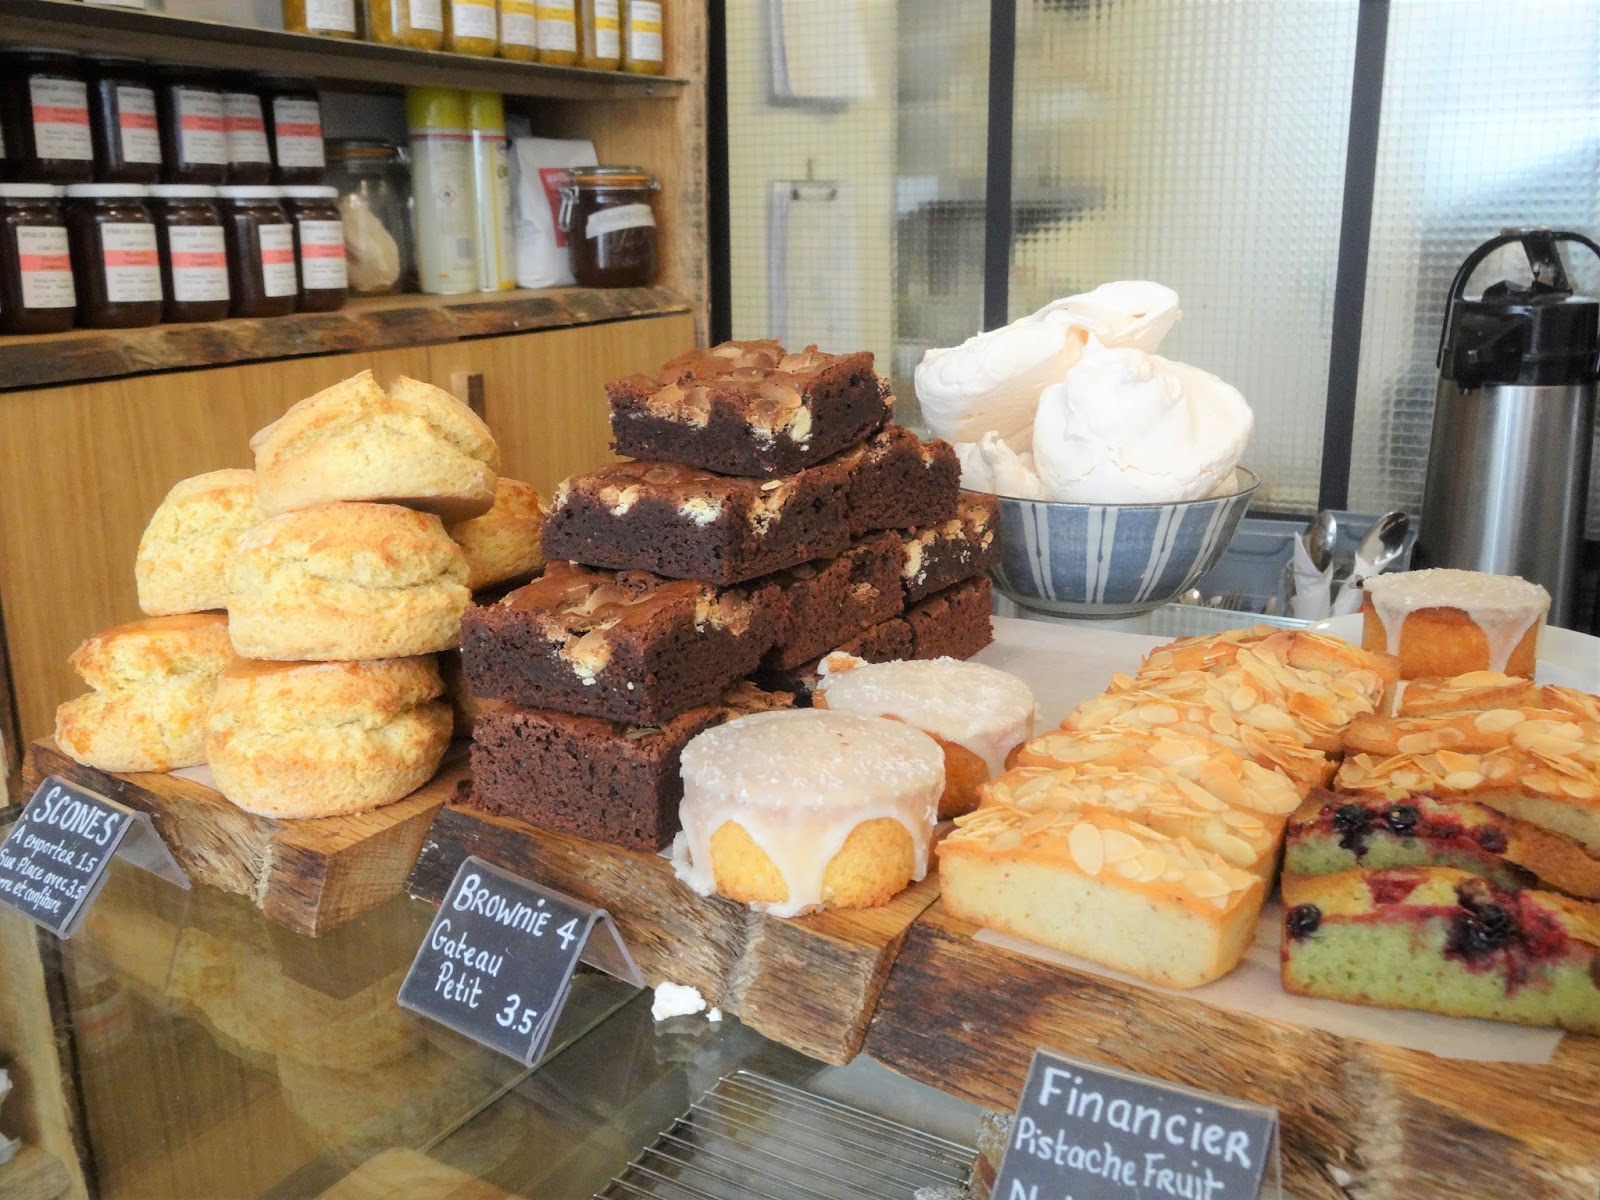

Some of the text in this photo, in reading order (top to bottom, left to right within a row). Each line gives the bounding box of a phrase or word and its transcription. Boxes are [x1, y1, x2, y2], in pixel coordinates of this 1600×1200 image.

[11, 824, 27, 844] A
[32, 785, 120, 846] SCONES
[12, 879, 27, 898] et
[24, 885, 62, 913] confiture
[43, 872, 68, 891] avec
[431, 919, 503, 978] Gateau
[556, 918, 579, 950] 4
[434, 961, 482, 1009] Petit
[496, 994, 537, 1034] 3.5
[1015, 1116, 1137, 1187] Pistache
